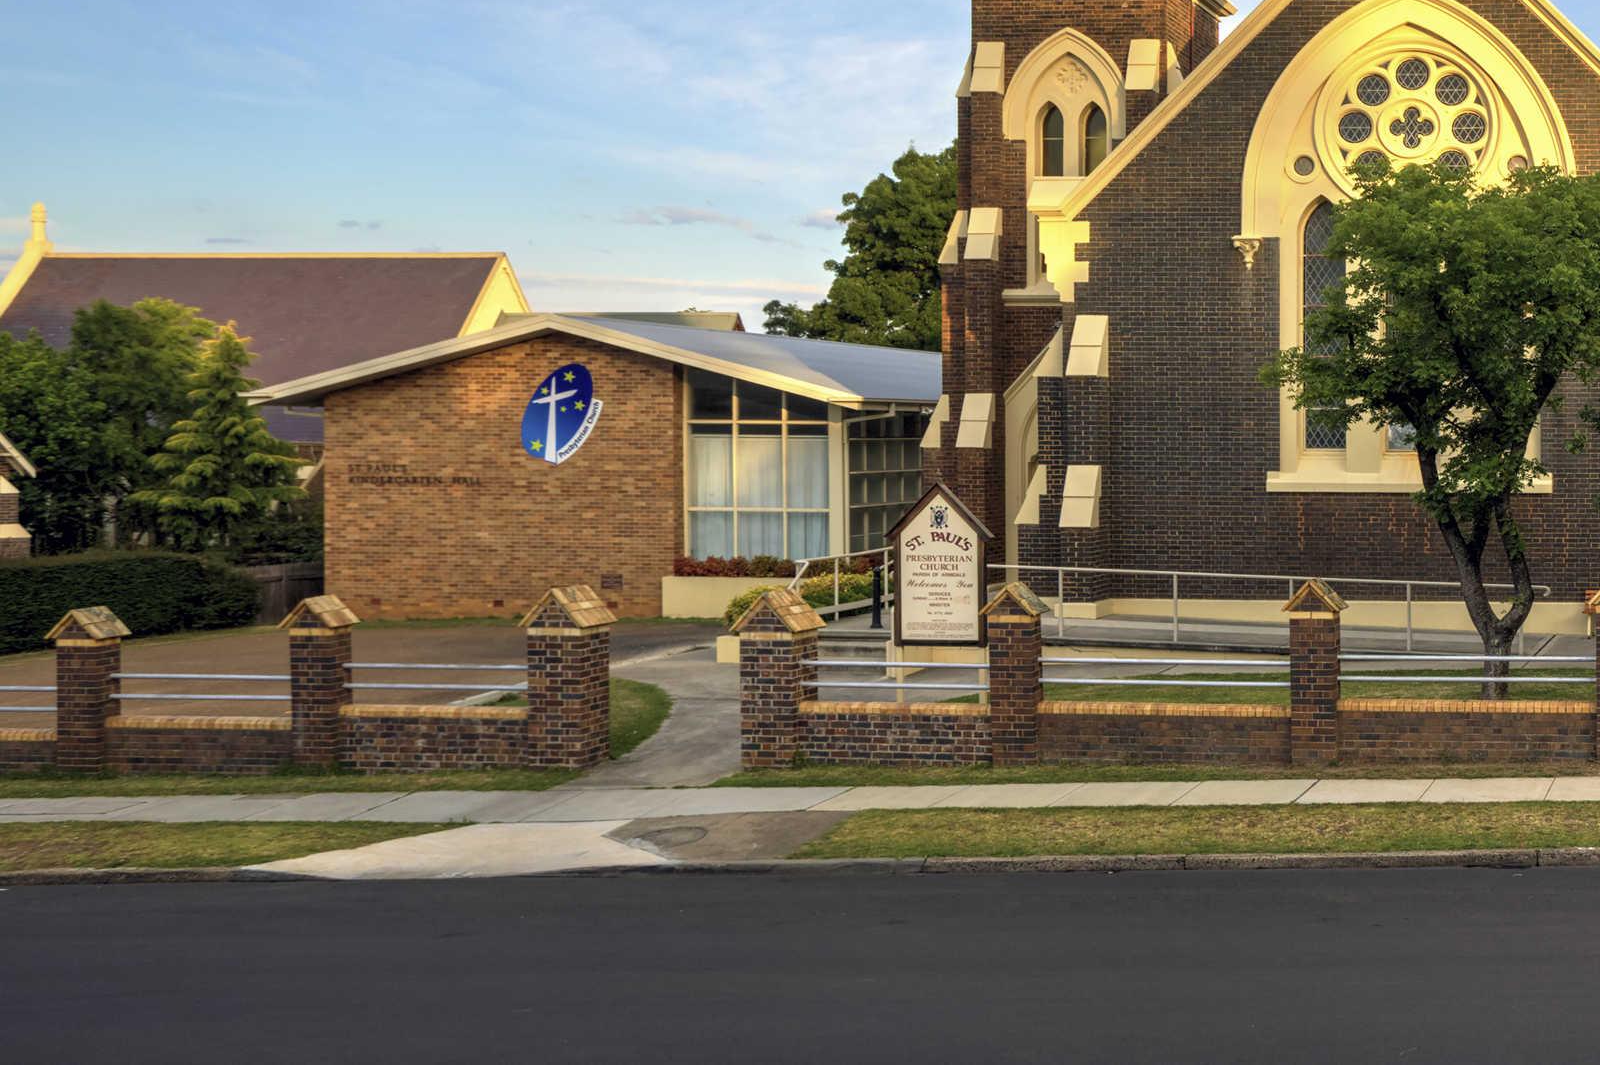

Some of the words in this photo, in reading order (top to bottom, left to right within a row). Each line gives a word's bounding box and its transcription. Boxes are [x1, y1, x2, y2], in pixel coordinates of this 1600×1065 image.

[558, 425, 589, 459] Presbyterian
[586, 401, 600, 424] Church
[905, 535, 925, 551] ST.
[930, 531, 973, 551] PAUL'S
[905, 555, 973, 563] PRESBYTERIAN
[919, 563, 959, 571] CHURCH
